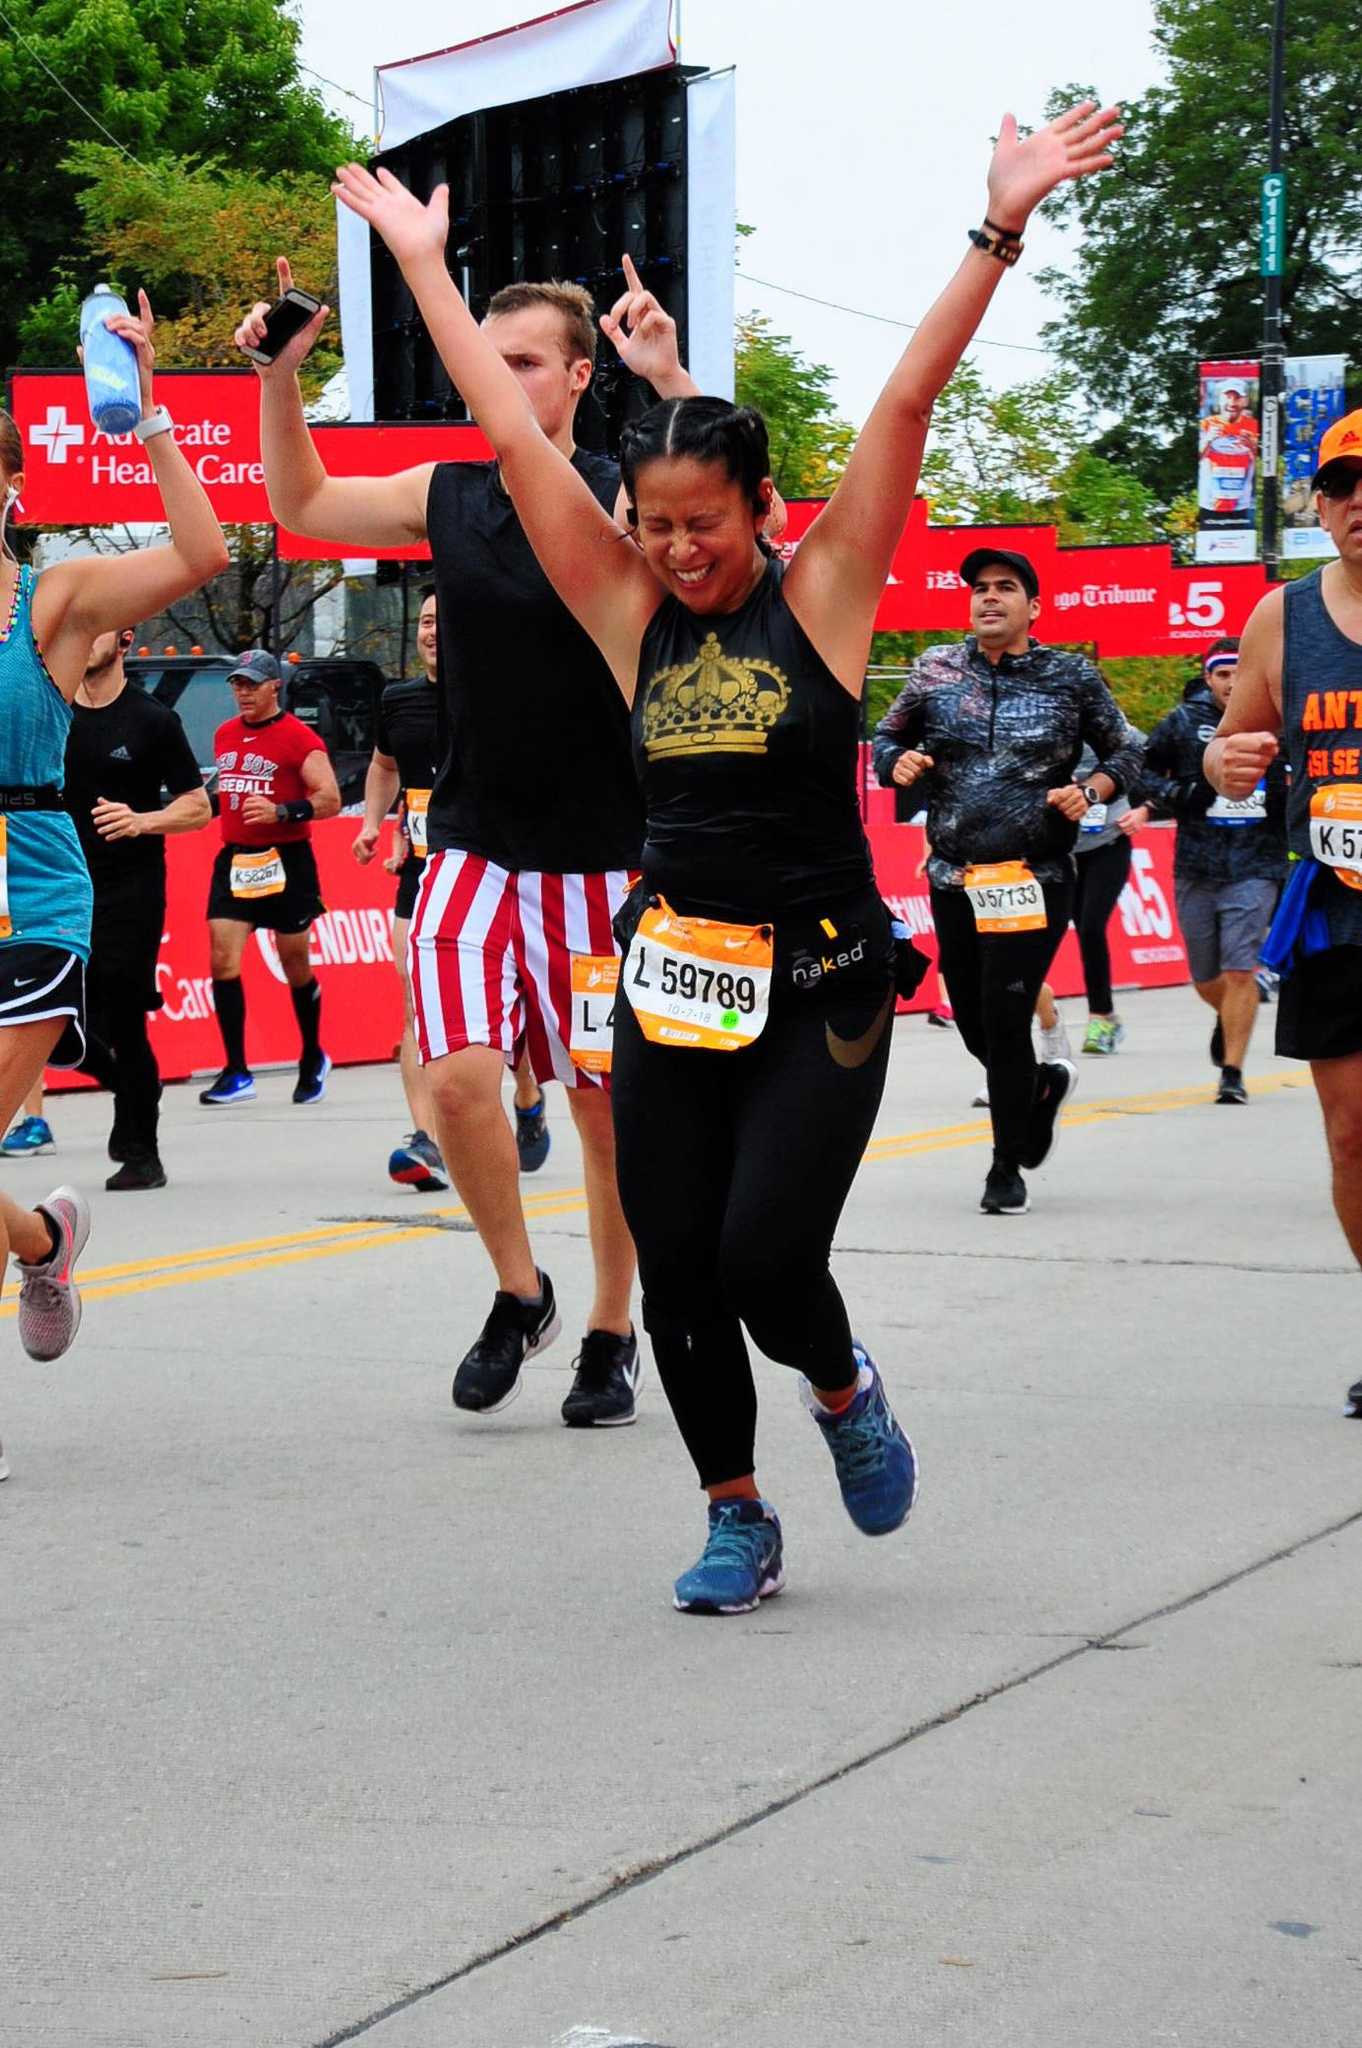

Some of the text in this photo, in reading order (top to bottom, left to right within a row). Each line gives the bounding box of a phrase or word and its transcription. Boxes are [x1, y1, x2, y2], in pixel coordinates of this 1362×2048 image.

[1263, 178, 1281, 271] C1111
[92, 455, 265, 484] Hea Care
[1082, 584, 1157, 607] Tribune
[1186, 581, 1225, 627] 5
[216, 752, 278, 781] ED SOX
[1333, 749, 1360, 776] SE
[219, 778, 275, 795] SEBALL
[793, 942, 864, 983] naked
[661, 957, 756, 1014] 59789
